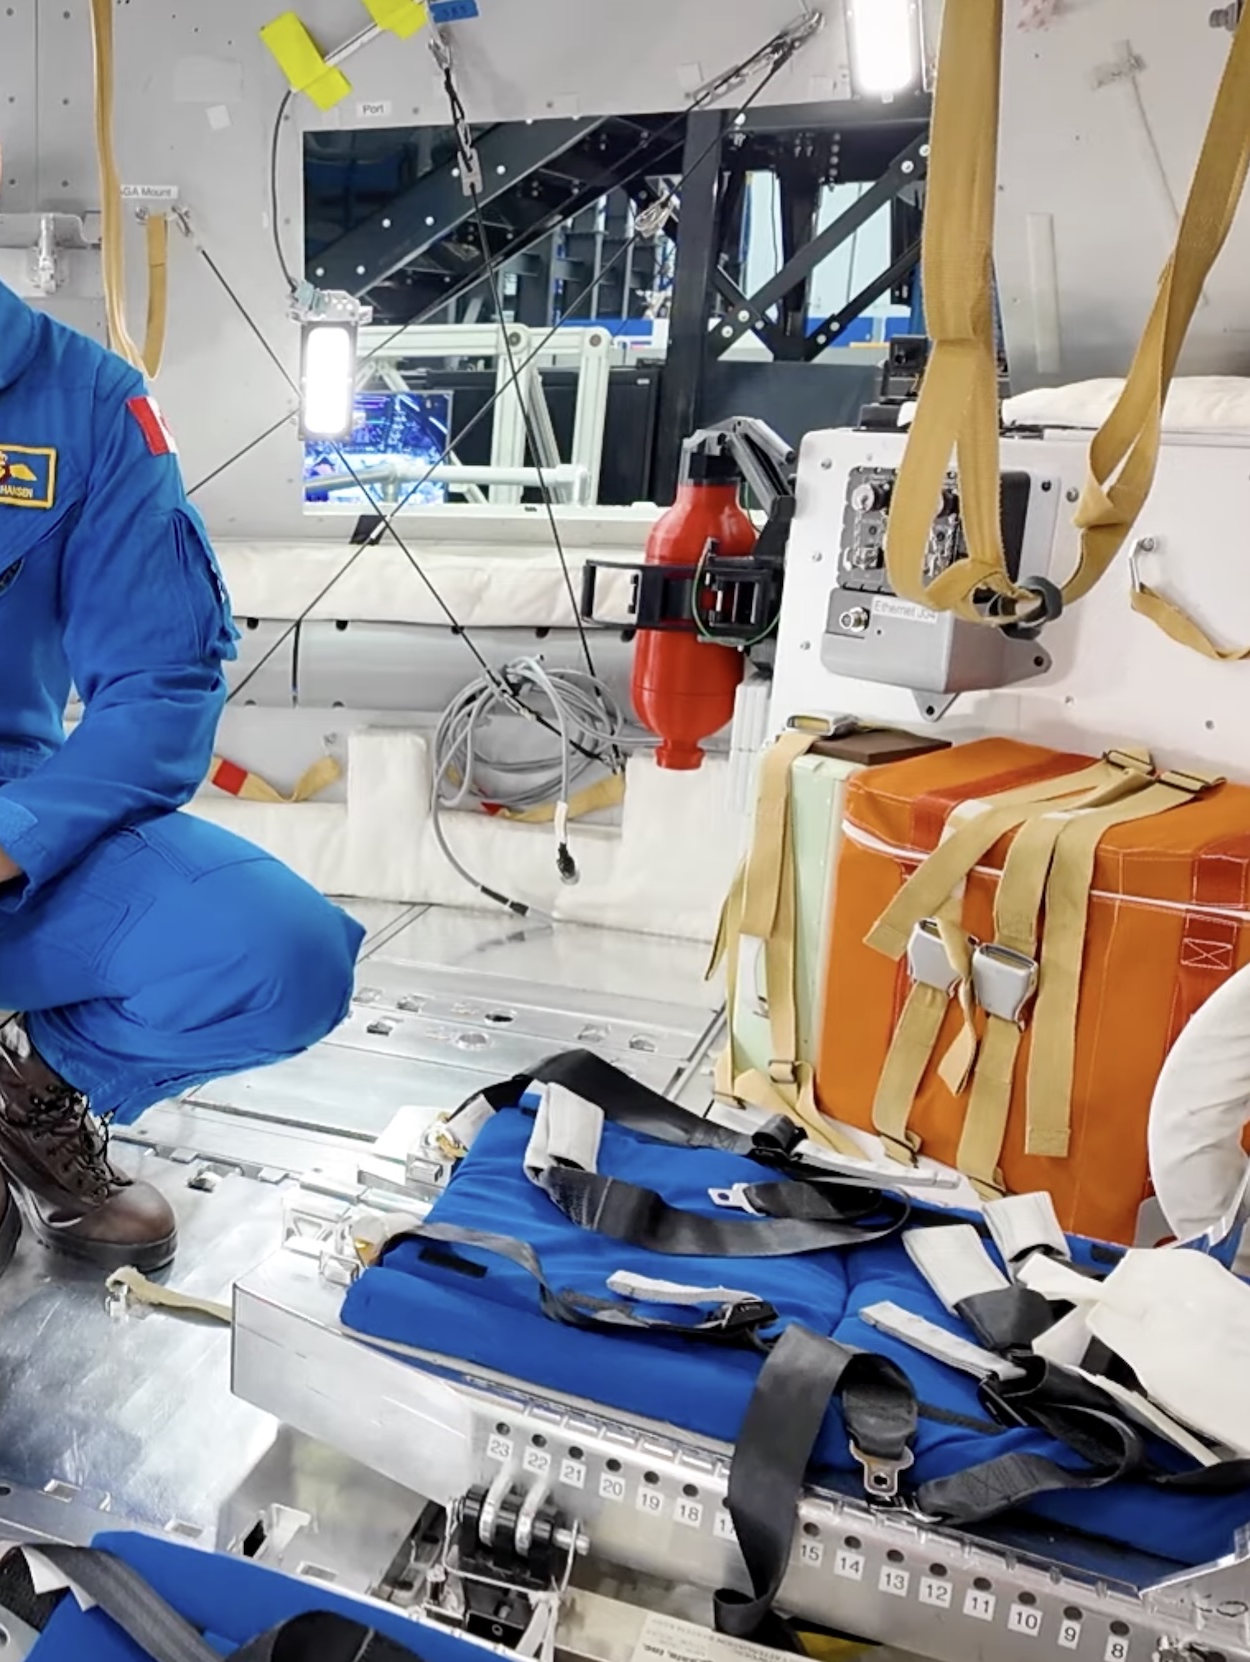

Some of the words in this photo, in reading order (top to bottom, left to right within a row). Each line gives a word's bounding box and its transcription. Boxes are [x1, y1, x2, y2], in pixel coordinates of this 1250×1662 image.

[362, 103, 385, 116] Port
[141, 186, 171, 197] Mount
[874, 599, 916, 618] Ethernet
[490, 1440, 510, 1458] 23
[528, 1453, 548, 1470] 22
[563, 1465, 582, 1482] 21
[602, 1478, 623, 1496] 20
[642, 1493, 661, 1511] 19
[680, 1505, 700, 1522] 18
[802, 1544, 820, 1561] 15
[840, 1556, 860, 1574] 14
[885, 1572, 906, 1590] 13
[927, 1583, 948, 1602] 12
[972, 1596, 990, 1614] 11
[1016, 1611, 1038, 1630] 10
[1064, 1626, 1077, 1642] 9
[1110, 1643, 1125, 1660] 8
